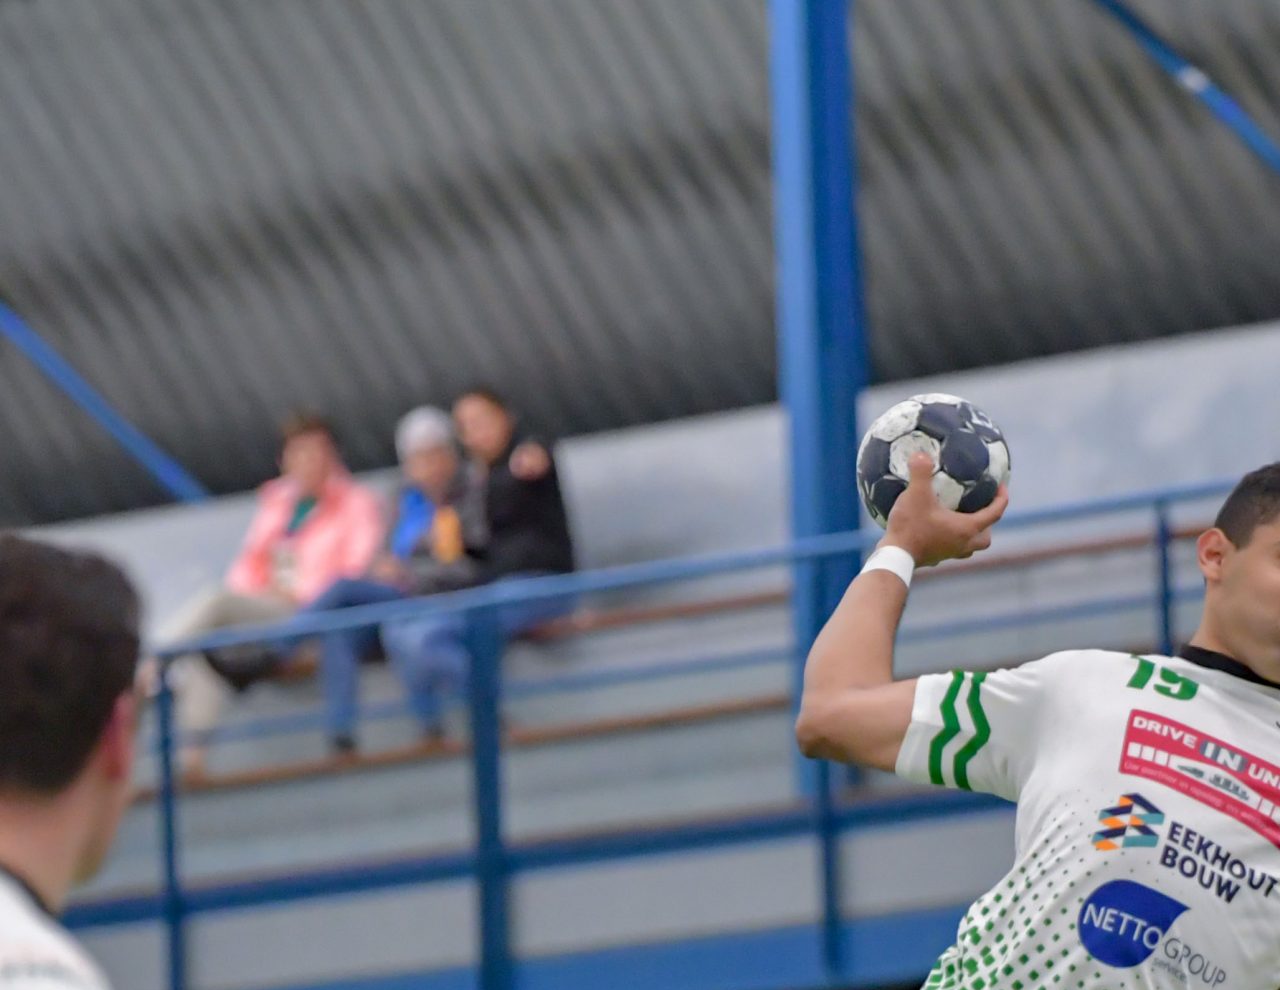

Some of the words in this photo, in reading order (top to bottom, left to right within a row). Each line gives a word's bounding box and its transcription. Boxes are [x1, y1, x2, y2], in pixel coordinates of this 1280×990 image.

[1132, 715, 1199, 750] DRIVE
[1203, 741, 1244, 773] IN
[1160, 844, 1241, 904] BOUW
[1167, 821, 1279, 898] EEKHOUT
[1083, 903, 1164, 950] NETTO
